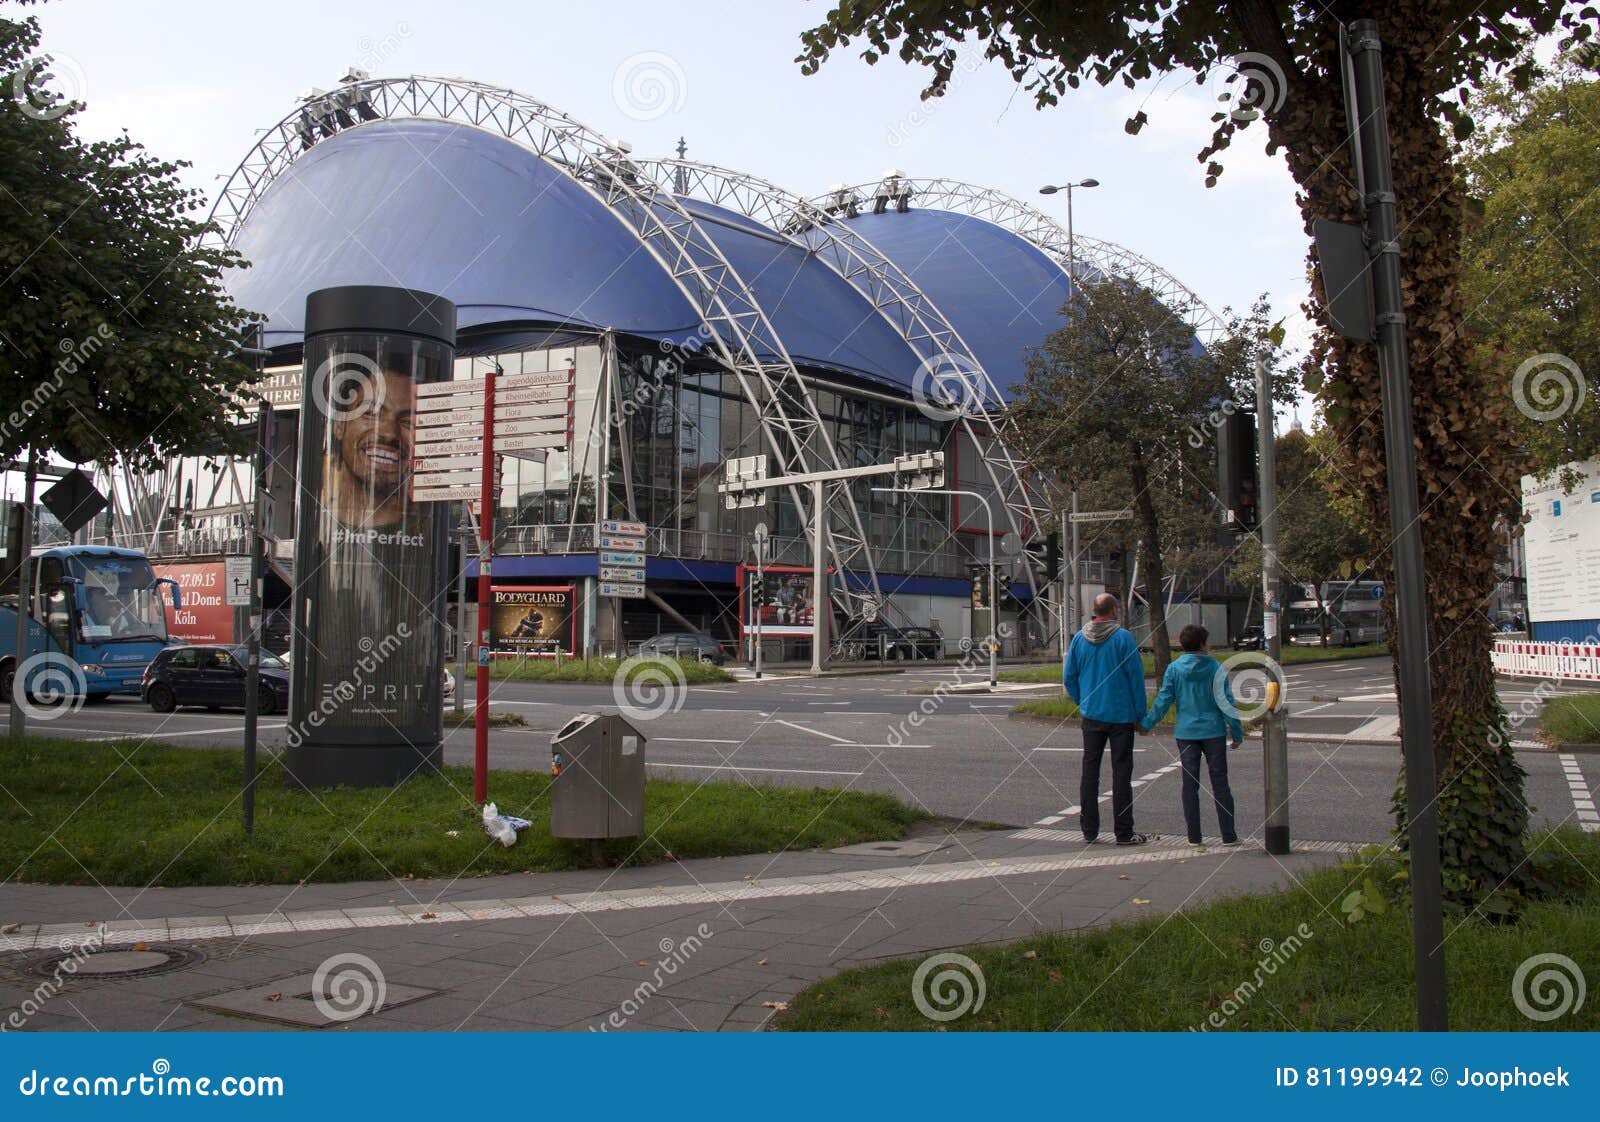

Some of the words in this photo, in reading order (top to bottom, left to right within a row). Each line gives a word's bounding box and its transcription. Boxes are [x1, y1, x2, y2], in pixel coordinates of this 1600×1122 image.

[505, 408, 521, 416] Flora
[505, 424, 518, 432] Zoo
[423, 476, 442, 484] Deutz
[334, 528, 424, 547] #ImPerfect
[180, 573, 216, 587] 27.09.15
[191, 591, 221, 606] Dome
[495, 592, 566, 603] BODYGUARD
[174, 610, 197, 625] Köln
[322, 684, 424, 701] ESPRIT
